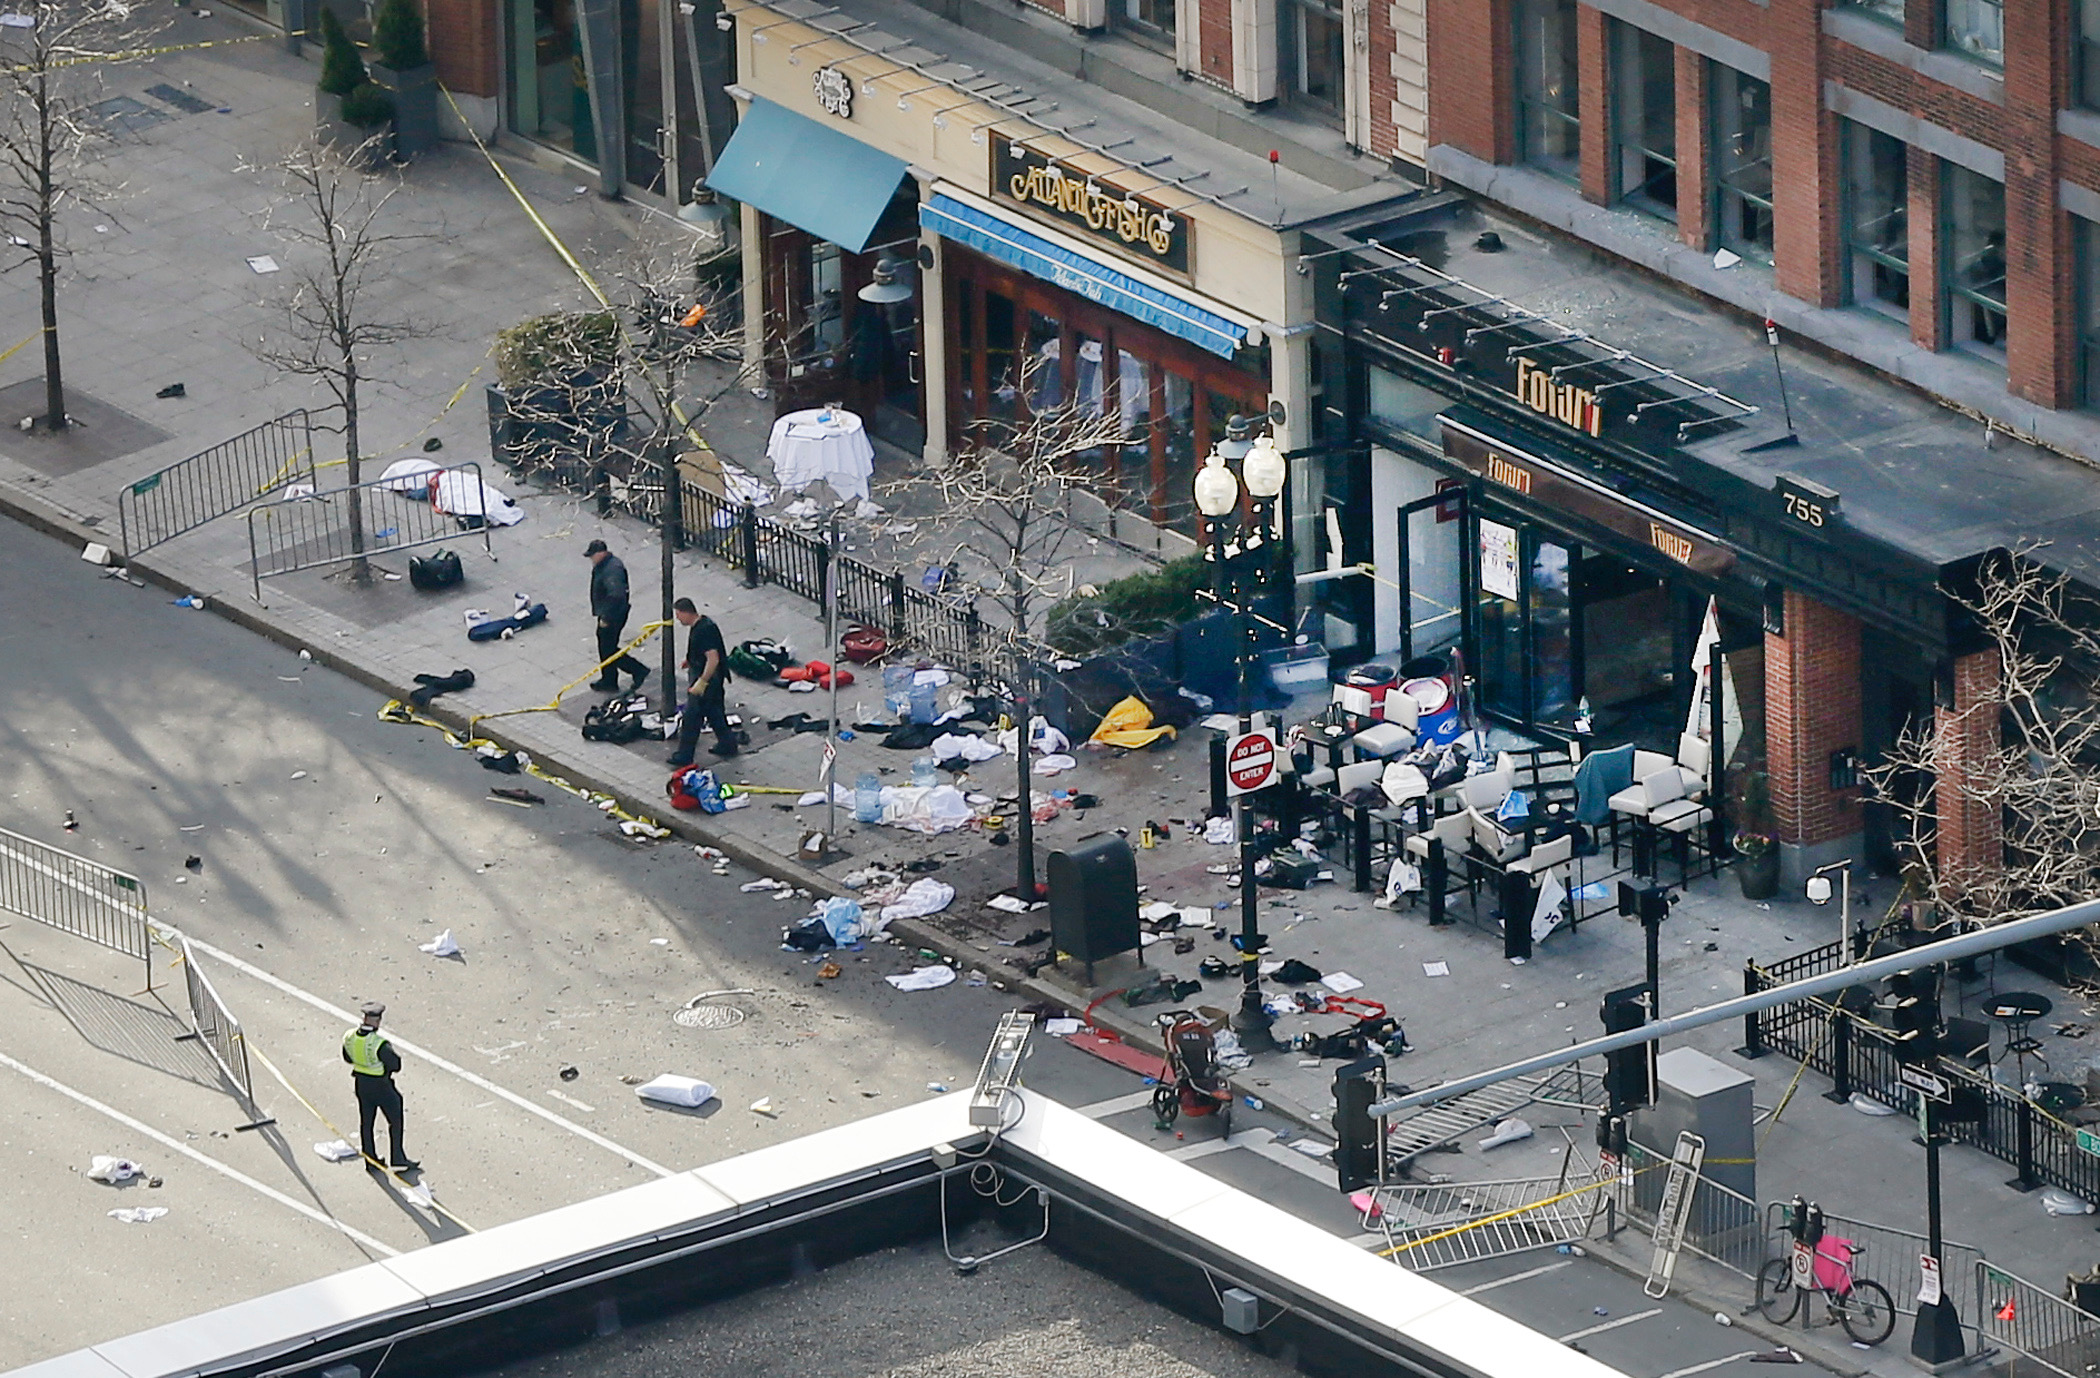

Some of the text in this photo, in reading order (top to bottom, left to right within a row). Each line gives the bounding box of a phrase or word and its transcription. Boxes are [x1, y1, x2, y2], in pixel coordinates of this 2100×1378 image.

[1782, 492, 1823, 527] 755
[1237, 741, 1266, 758] DO NOT
[1239, 766, 1265, 781] ENTER
